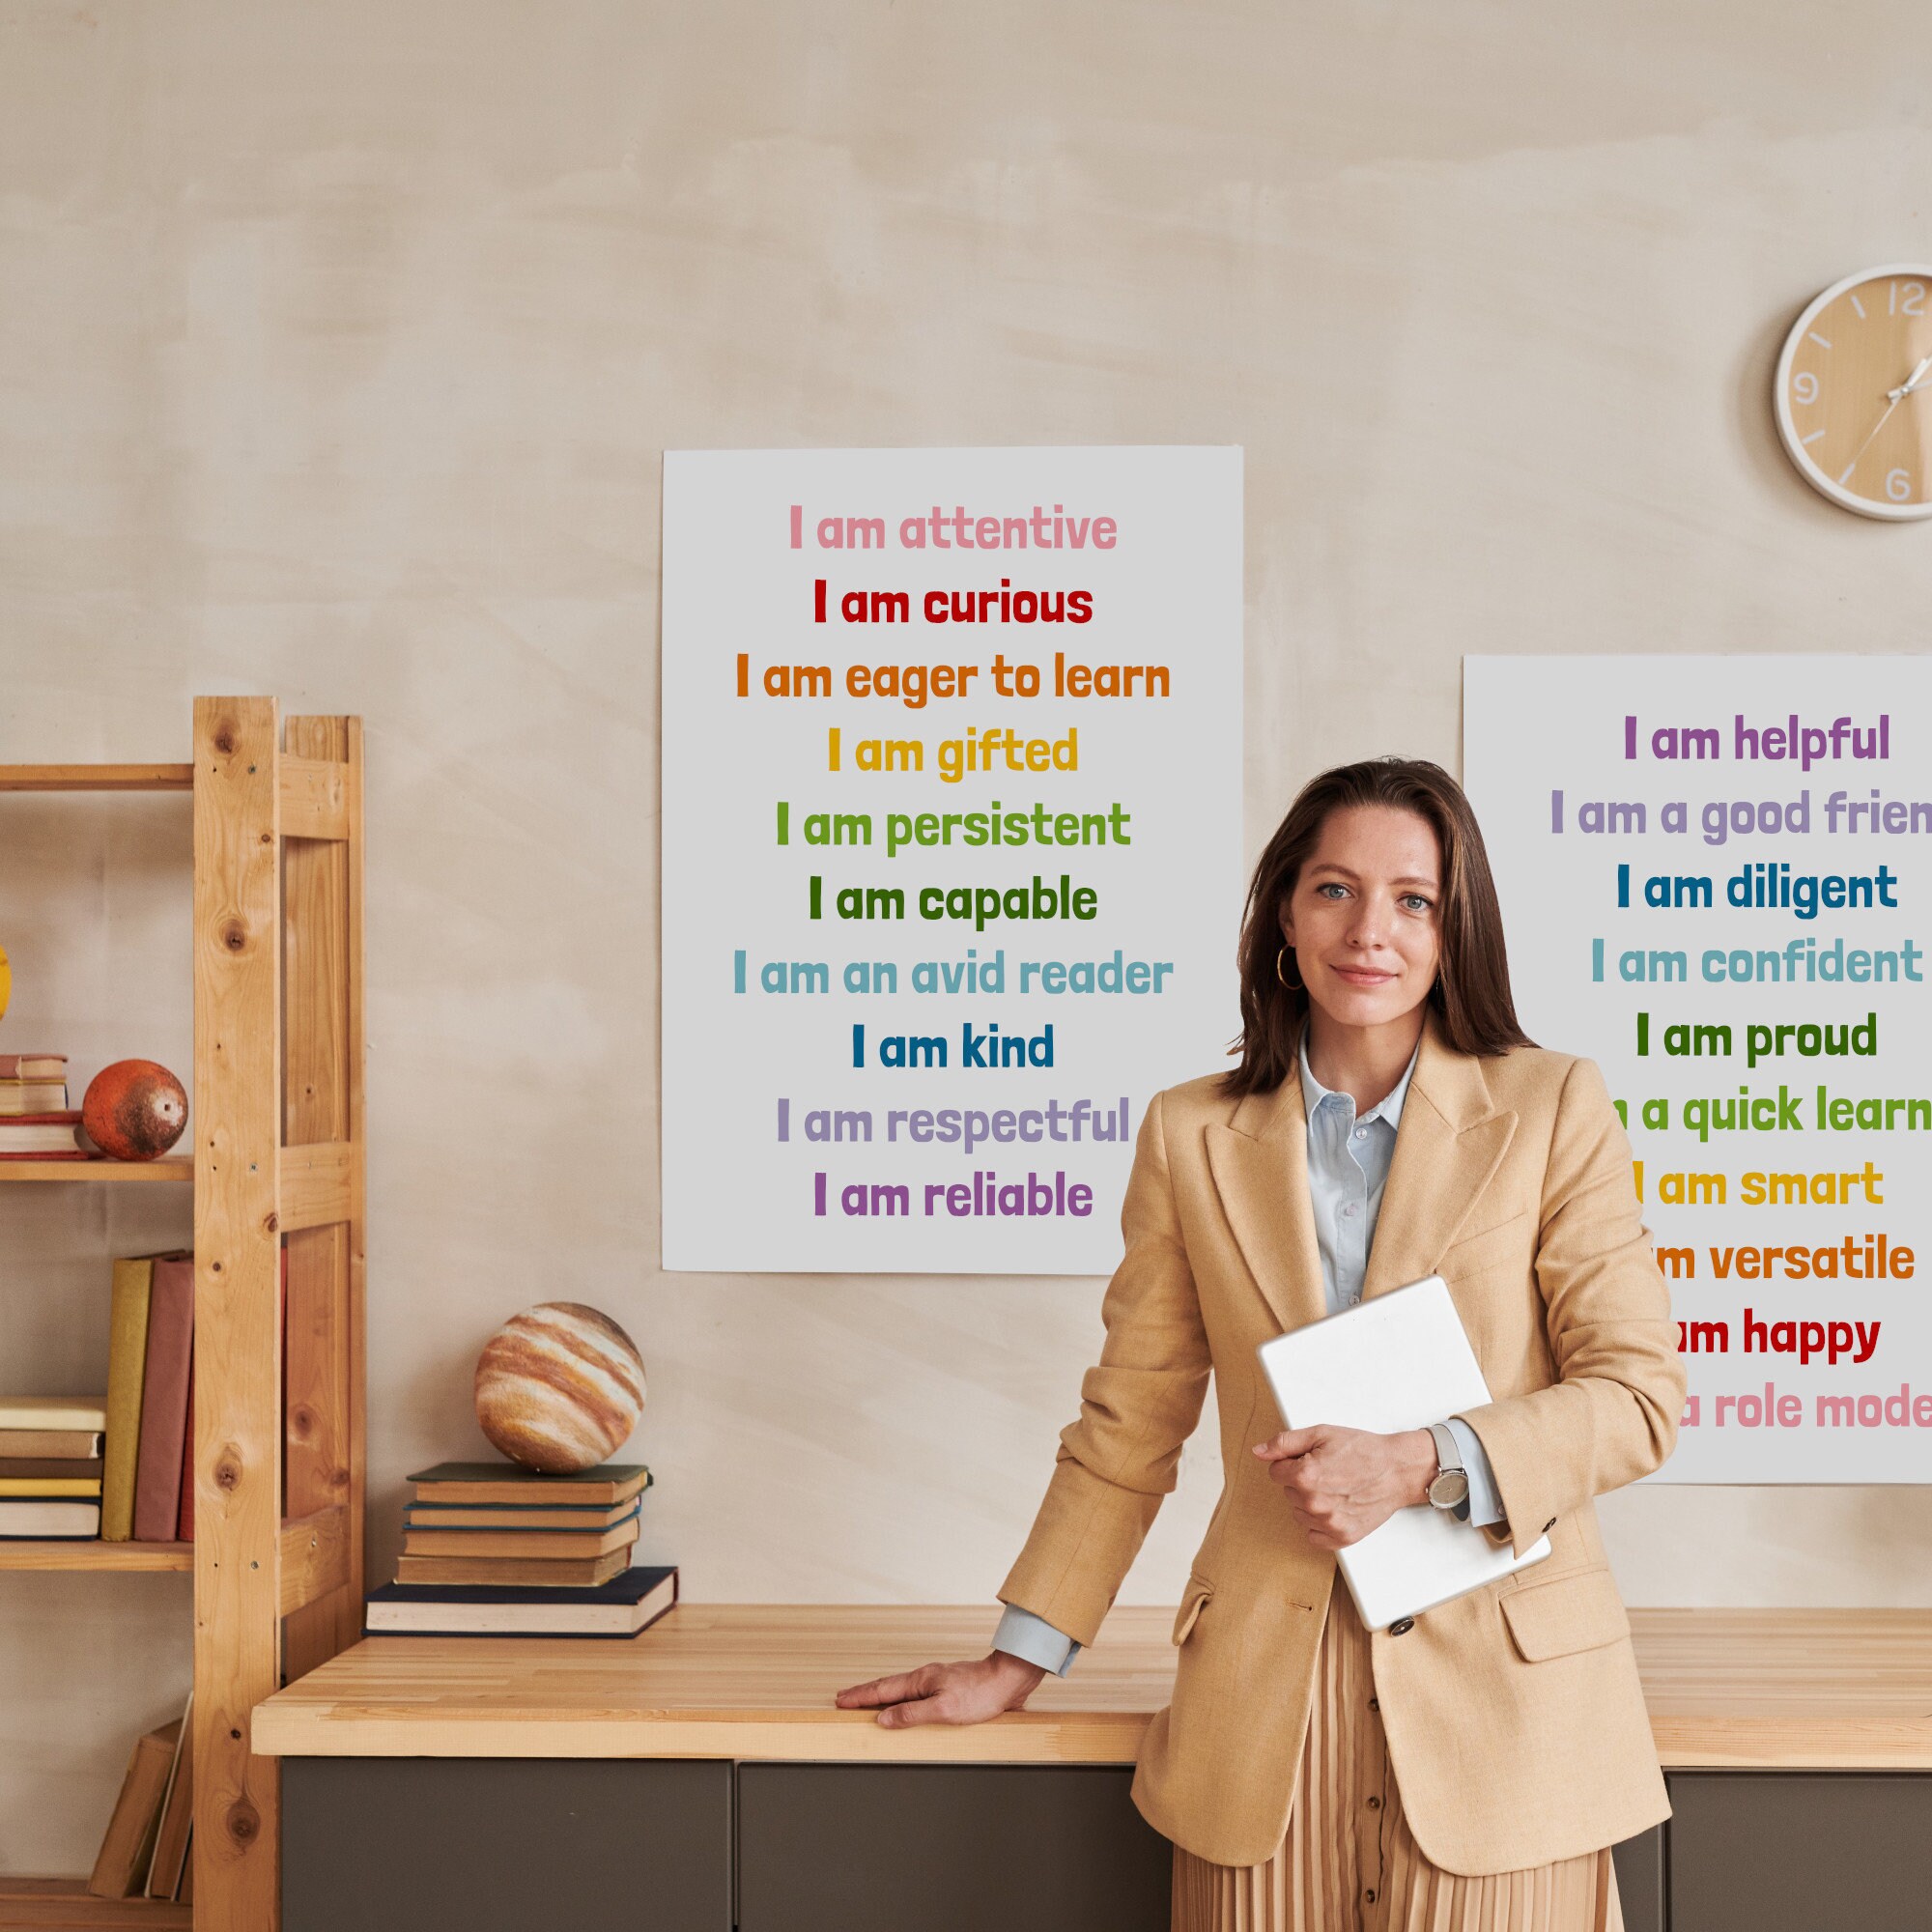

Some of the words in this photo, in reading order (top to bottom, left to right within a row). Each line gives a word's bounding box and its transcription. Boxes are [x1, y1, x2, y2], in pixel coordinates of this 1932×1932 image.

[1889, 281, 1926, 317] 12
[1793, 371, 1820, 406] 9
[1885, 467, 1912, 502] 6
[791, 505, 802, 549] I
[817, 518, 885, 549] am
[900, 504, 1117, 549] attentive
[814, 580, 827, 623] I
[841, 591, 909, 623] am
[924, 579, 1093, 624] curious
[737, 653, 749, 697] I
[763, 666, 832, 697] am
[846, 665, 979, 709] eager
[991, 655, 1040, 697] to
[1055, 652, 1170, 697] learn
[829, 727, 840, 772] I
[855, 740, 923, 771] am
[938, 726, 1078, 783] gifted
[1625, 716, 1636, 759] I
[1652, 728, 1719, 759] am
[1735, 715, 1889, 772] helpful
[777, 802, 789, 845] I
[804, 813, 871, 845] am
[887, 801, 1131, 858] persistent
[1552, 790, 1563, 833] I
[1578, 803, 1646, 833] am
[1662, 803, 1687, 833] a
[1702, 790, 1809, 845] good
[810, 876, 822, 920] I
[837, 889, 904, 920] am
[920, 874, 1097, 932] capable
[1618, 864, 1630, 908] I
[1644, 876, 1712, 908] am
[1727, 863, 1897, 920] diligent
[734, 951, 746, 993] I
[761, 962, 829, 993] am
[843, 962, 896, 993] an
[912, 950, 1005, 993] avid
[1020, 950, 1174, 994] reader
[1593, 939, 1604, 981] I
[1619, 951, 1687, 981] am
[1702, 938, 1922, 982] confident
[853, 1024, 865, 1067] I
[879, 1037, 948, 1067] am
[963, 1023, 1054, 1067] kind
[1637, 1012, 1649, 1056] I
[1663, 1025, 1732, 1056] am
[1747, 1012, 1877, 1068] proud
[779, 1098, 789, 1142] I
[805, 1111, 871, 1142] am
[888, 1097, 1128, 1153] respectful
[1642, 1099, 1668, 1130] a
[1683, 1085, 1804, 1143] quick
[815, 1173, 826, 1216] I
[841, 1184, 909, 1216] am
[924, 1171, 1093, 1216] reliable
[1659, 1173, 1726, 1205] am
[1741, 1161, 1884, 1206] smart
[1652, 1247, 1695, 1279] m
[1709, 1234, 1915, 1279] versatile
[1744, 1308, 1881, 1365] happy
[1716, 1382, 1802, 1427] role
